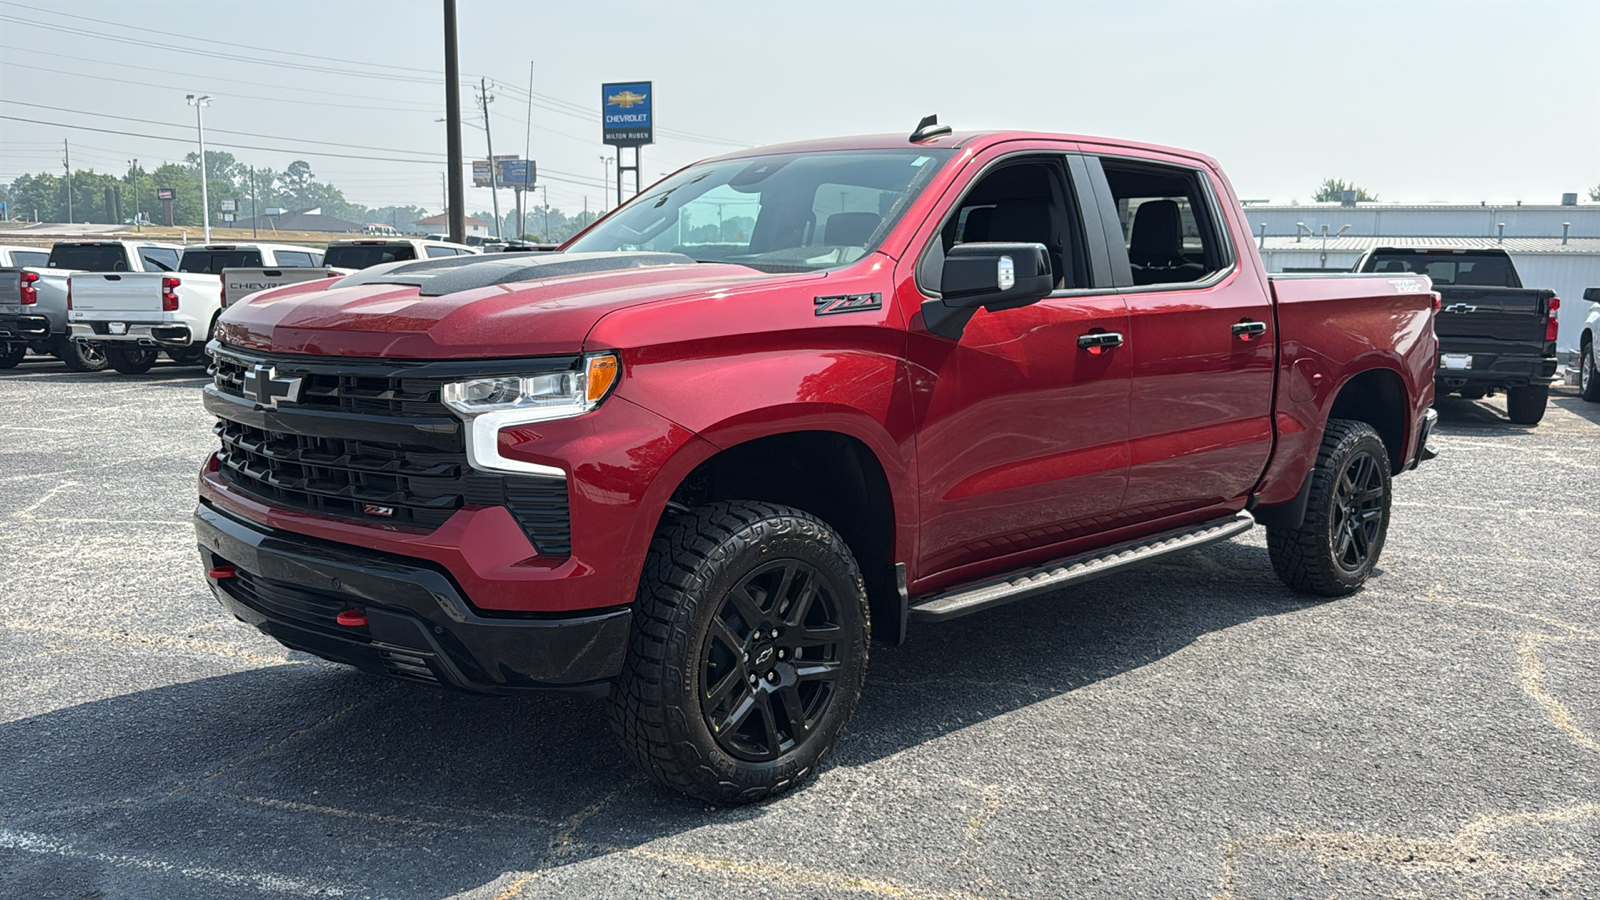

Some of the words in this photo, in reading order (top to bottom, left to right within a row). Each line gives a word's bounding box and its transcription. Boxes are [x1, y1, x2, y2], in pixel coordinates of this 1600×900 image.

[606, 113, 648, 123] CHEVROLET
[814, 292, 882, 316] Z71
[364, 504, 394, 517] Z71
